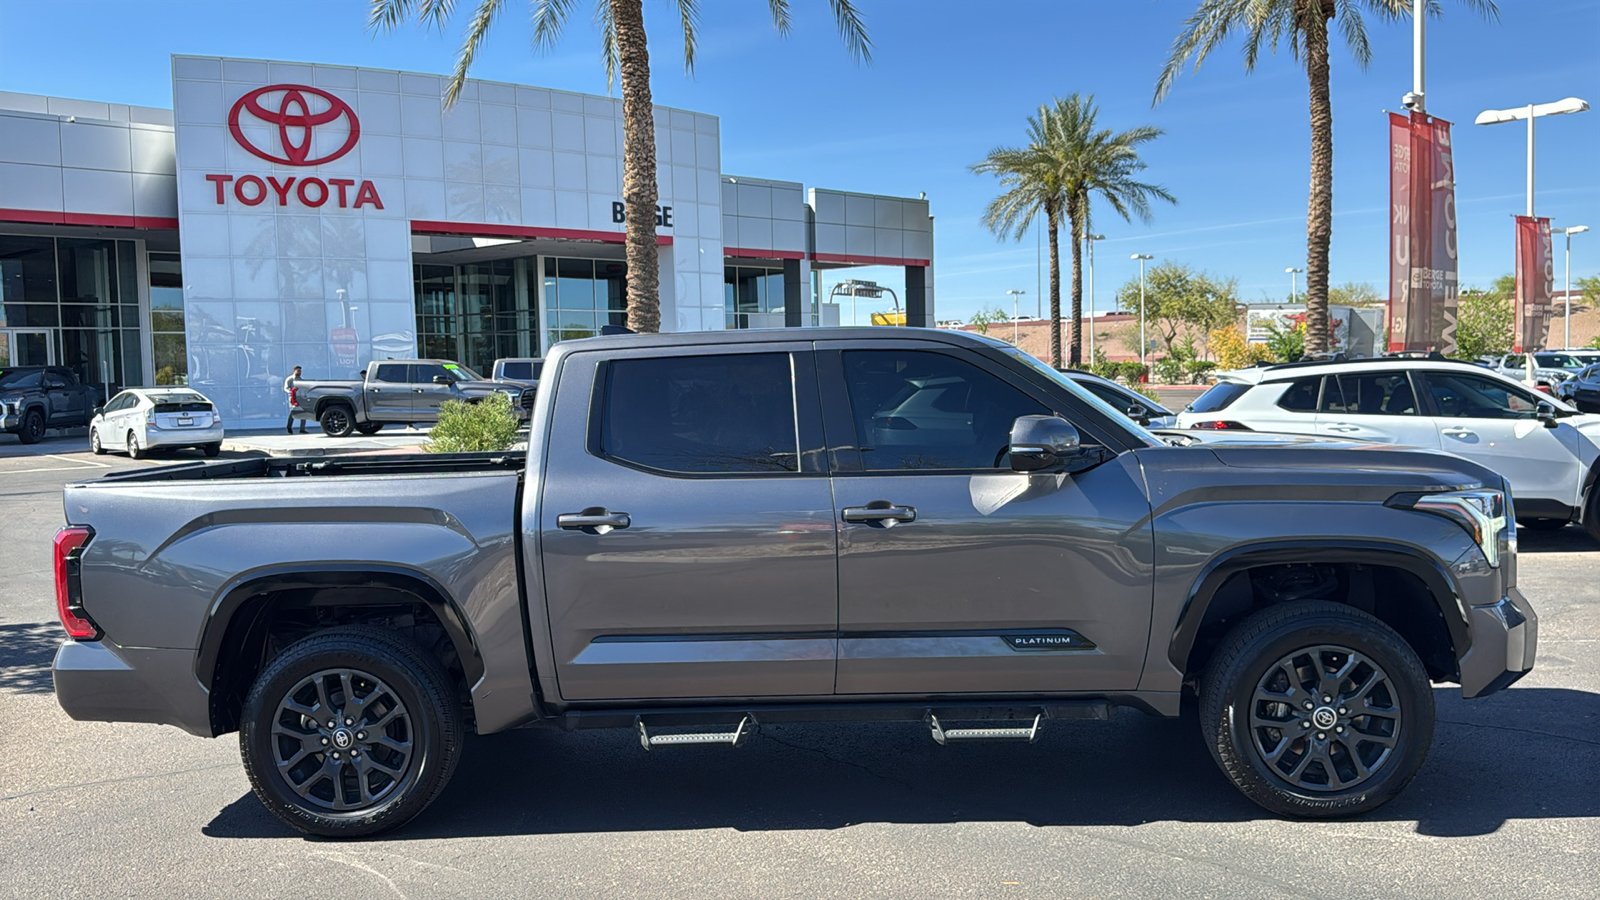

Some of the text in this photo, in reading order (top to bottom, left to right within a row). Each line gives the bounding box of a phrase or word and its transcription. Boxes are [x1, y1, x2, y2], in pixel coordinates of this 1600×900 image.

[206, 174, 384, 209] TOYOTA
[612, 201, 673, 228] BGE
[1423, 281, 1443, 290] TOYOTA
